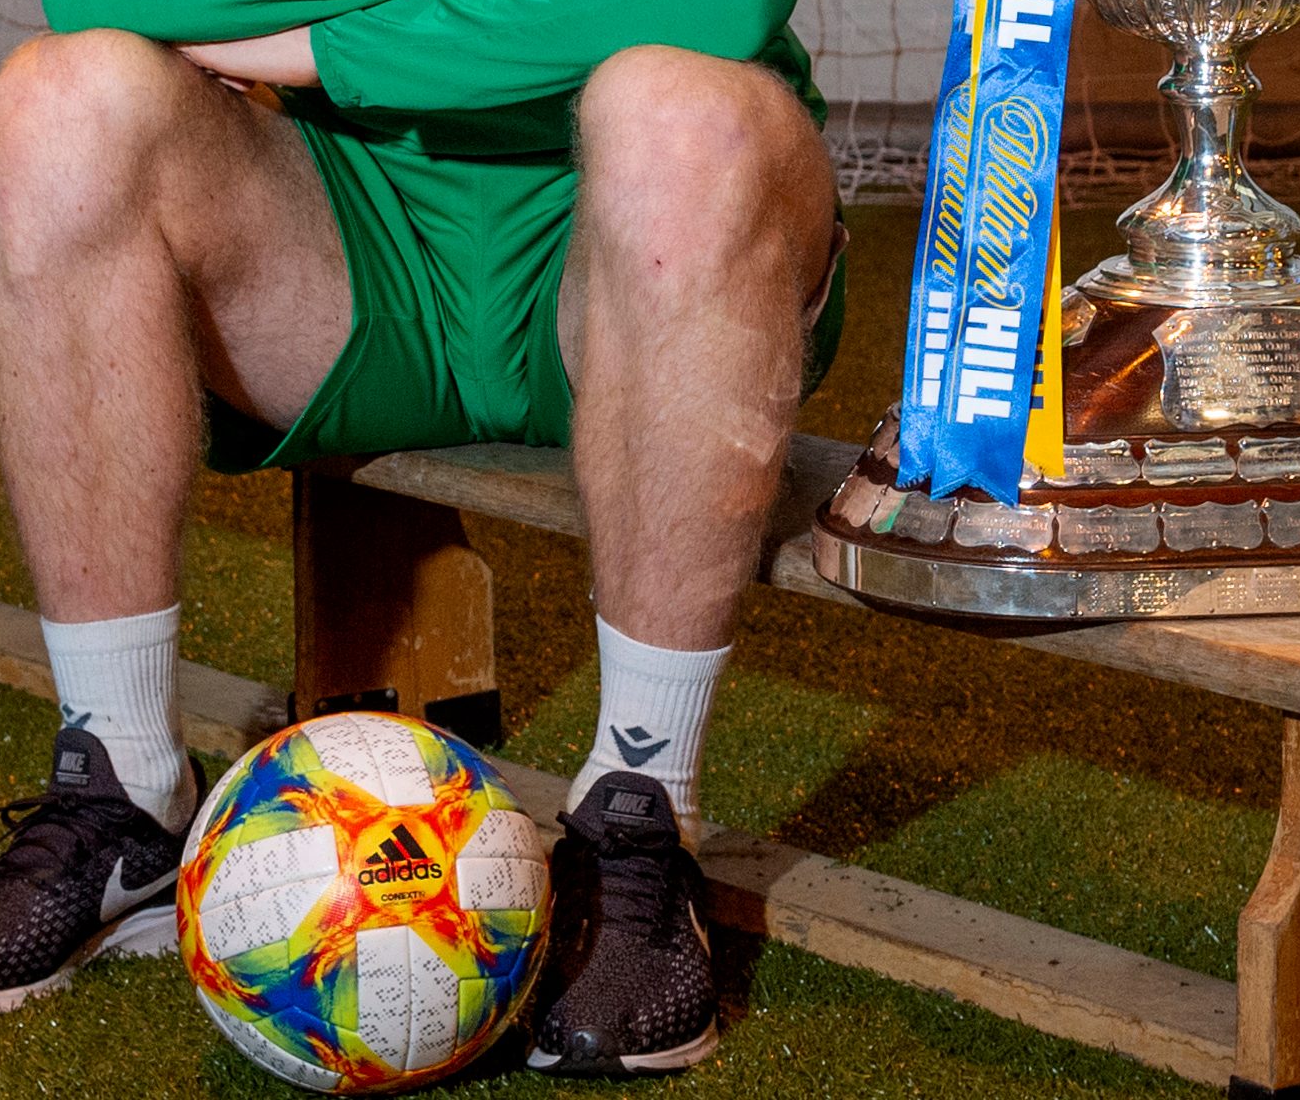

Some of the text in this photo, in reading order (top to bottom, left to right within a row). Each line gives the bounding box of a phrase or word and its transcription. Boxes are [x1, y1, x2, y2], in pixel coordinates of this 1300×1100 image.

[956, 94, 1049, 425] William HILL
[59, 751, 86, 772] NIKE
[608, 792, 652, 815] NIKE
[358, 860, 443, 886] adidas
